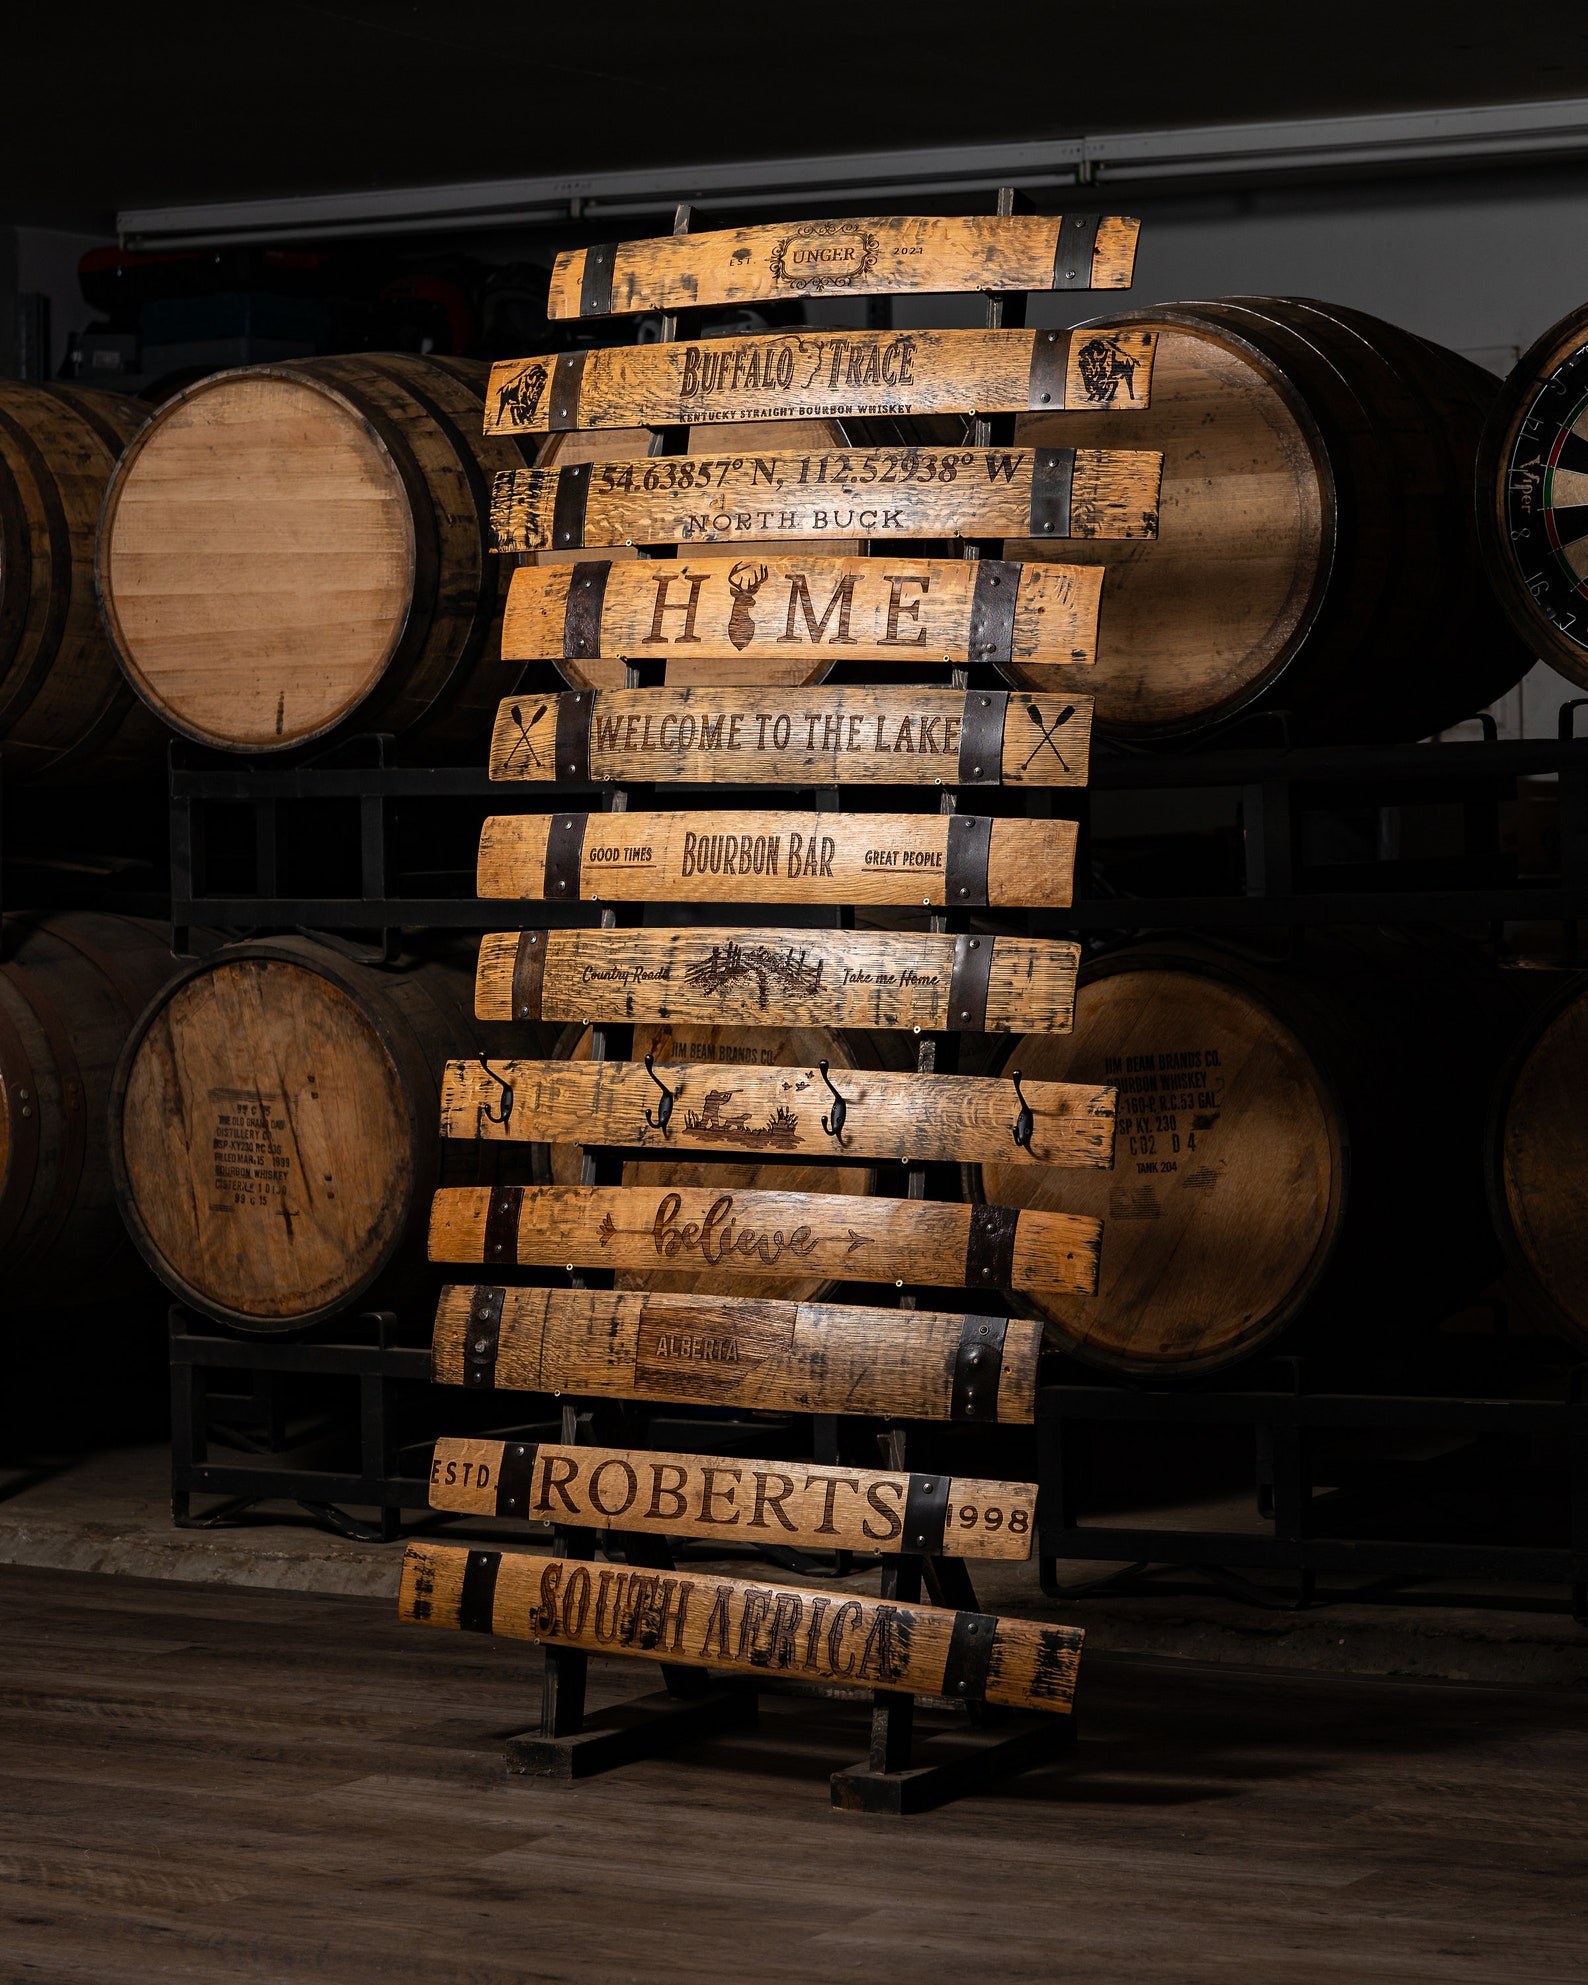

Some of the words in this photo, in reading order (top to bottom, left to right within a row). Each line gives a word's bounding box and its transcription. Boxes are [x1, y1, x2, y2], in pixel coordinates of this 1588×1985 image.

[729, 258, 757, 267] EST.
[793, 247, 855, 263] UNGER
[679, 346, 795, 399] BUFFALO
[828, 339, 918, 391] TRACE
[679, 410, 736, 423] KENTUCKY
[740, 407, 795, 418] STRAIGHT
[799, 405, 852, 415] BOURBON
[857, 404, 912, 414] WHISKEY
[751, 458, 784, 491] N,
[797, 453, 974, 484] 112.52938°
[985, 454, 1026, 483] W
[1514, 454, 1541, 514] Viper
[687, 511, 798, 532] NORTH
[812, 510, 904, 529] BUCK
[595, 714, 745, 751] WELCOME
[756, 714, 791, 750] TO
[804, 714, 864, 750] THE
[875, 715, 960, 753] LAKE
[589, 848, 620, 862] GOOD
[623, 847, 653, 862] TIMES
[681, 831, 781, 877] BOURBON
[787, 832, 836, 878] BAR
[864, 850, 901, 866] GREAT
[902, 851, 943, 867] PEOPLE
[582, 965, 630, 987] Country
[843, 968, 873, 986] Take
[875, 973, 898, 985] me
[898, 970, 941, 987] Home
[671, 1042, 687, 1058] JIM
[690, 1043, 716, 1060] BEAM
[719, 1045, 758, 1063] BRANDS
[1105, 1057, 1122, 1074] JIM
[1126, 1055, 1154, 1072] BEAM
[1159, 1052, 1202, 1070] BRANDS
[1205, 1050, 1221, 1067] CO.
[1160, 1071, 1208, 1091] WHISKEY
[1116, 1119, 1133, 1135] SP
[1136, 1117, 1153, 1133] KY.
[1156, 1115, 1177, 1131] 230
[1187, 1133, 1196, 1152] 4
[1137, 1162, 1158, 1174] TANK
[1161, 1161, 1177, 1172] 204
[653, 1192, 819, 1265] believe
[656, 1334, 738, 1361] ALBERTA
[532, 1456, 903, 1541] ROBERTS
[946, 1503, 1029, 1534] 1998
[534, 1562, 695, 1655] SOUTH
[700, 1584, 898, 1684] AFRICA
